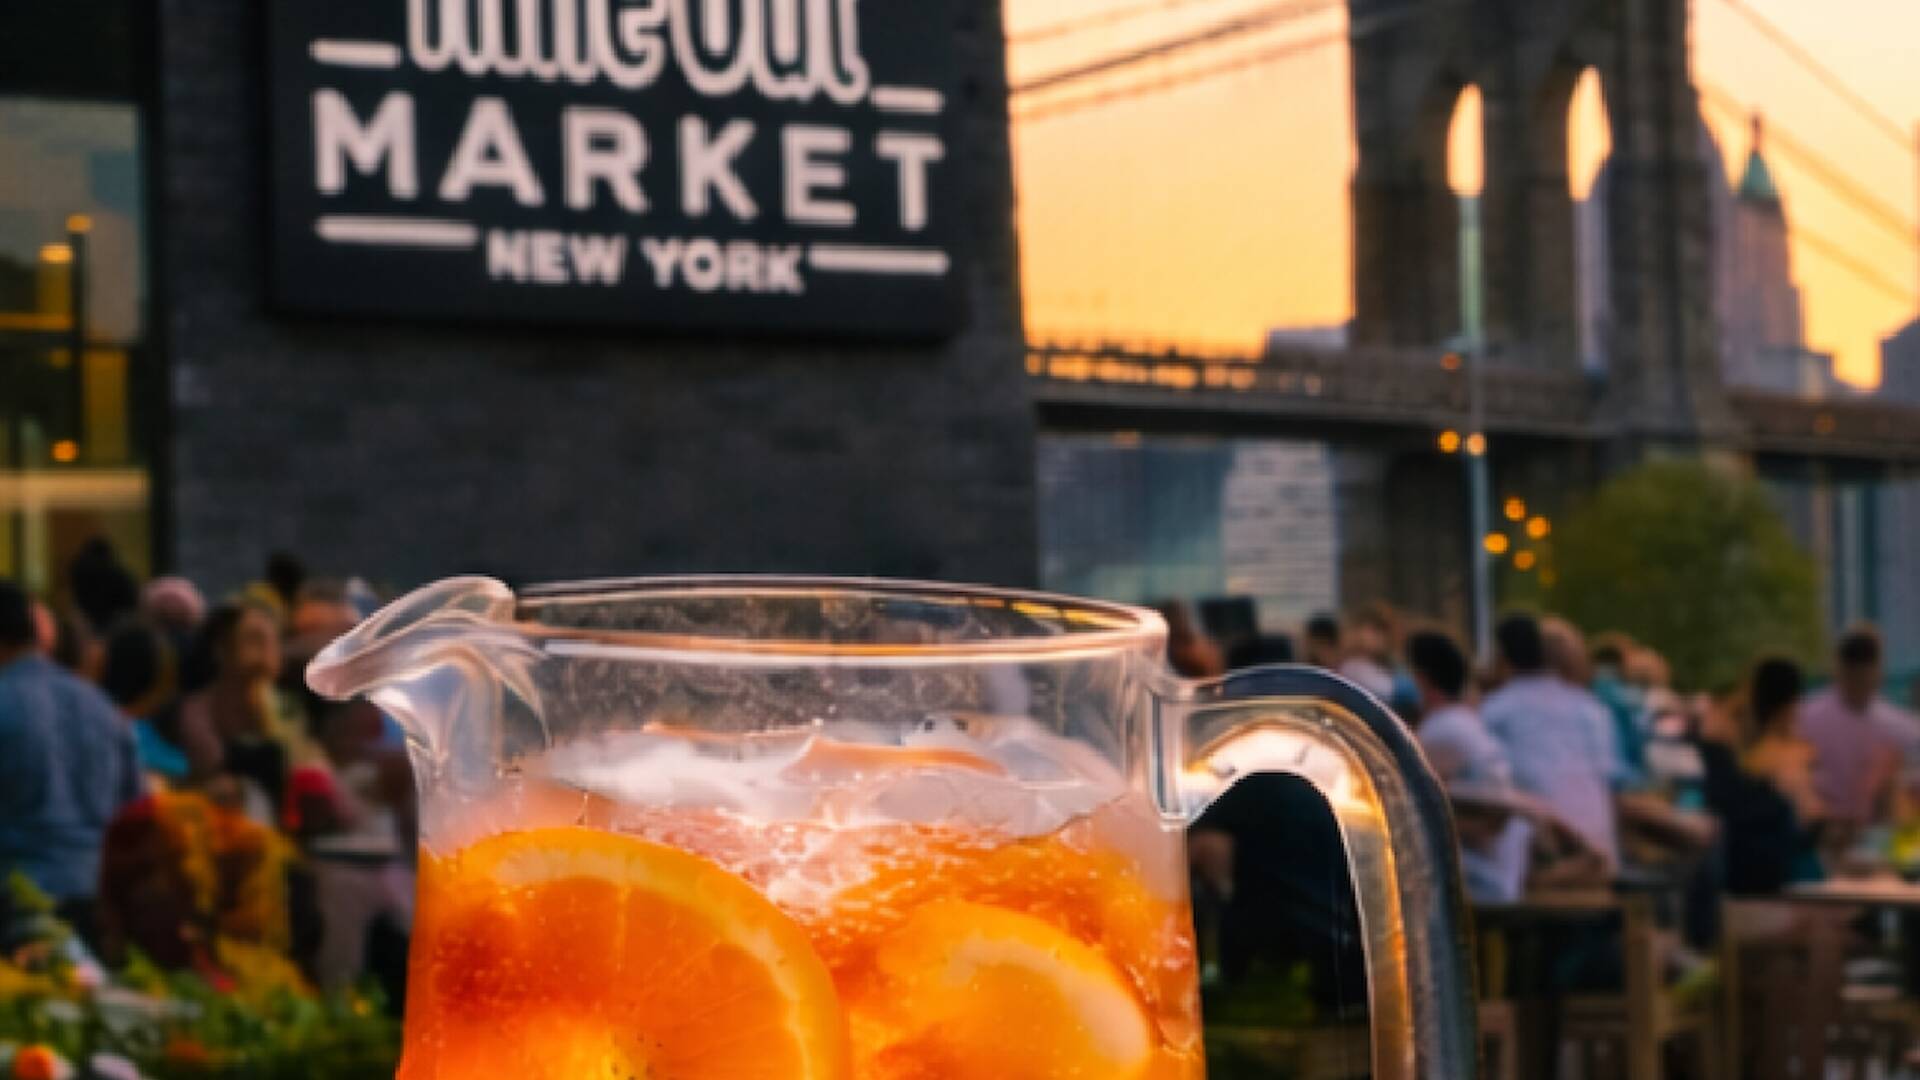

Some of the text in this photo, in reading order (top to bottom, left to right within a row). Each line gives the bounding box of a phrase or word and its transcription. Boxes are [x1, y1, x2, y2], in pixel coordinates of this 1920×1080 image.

[314, 88, 944, 231] MARKET
[487, 229, 804, 293] NEW YORK
